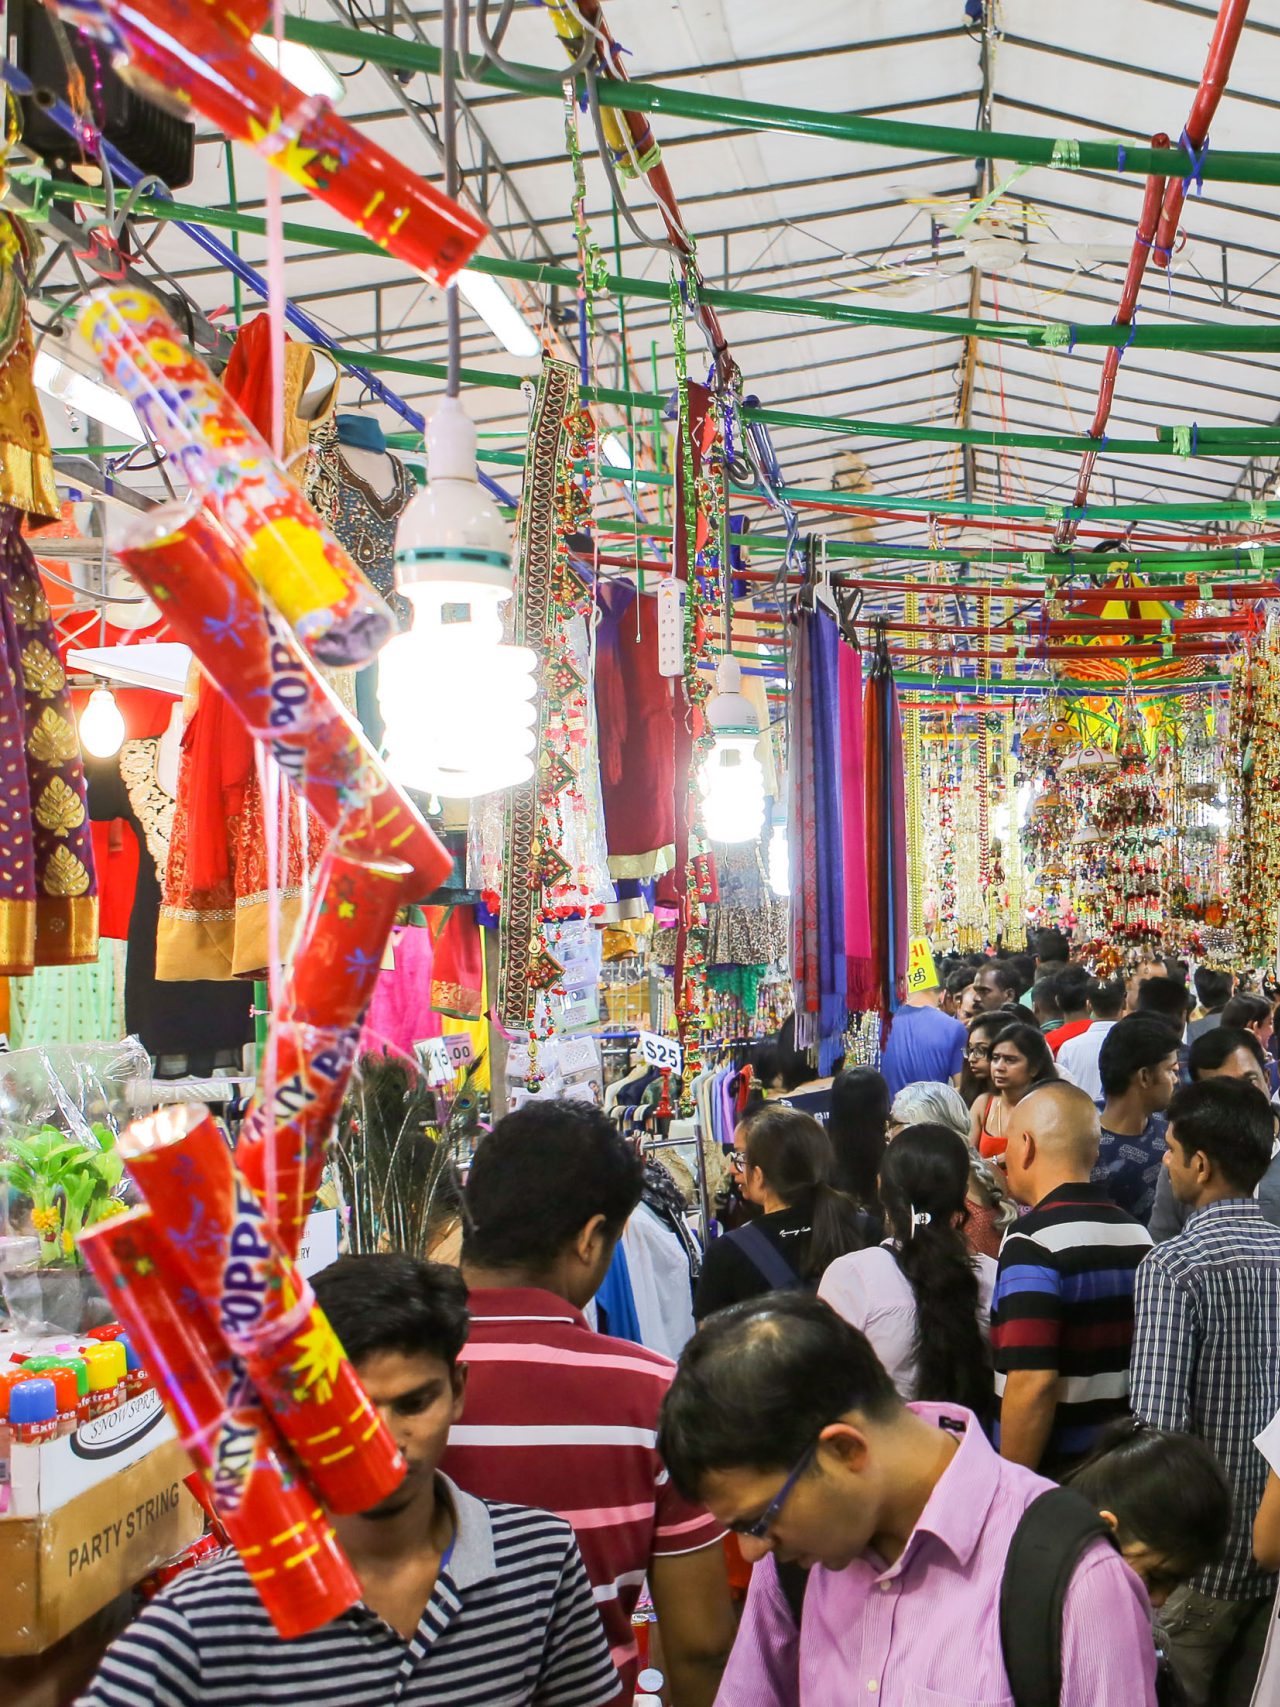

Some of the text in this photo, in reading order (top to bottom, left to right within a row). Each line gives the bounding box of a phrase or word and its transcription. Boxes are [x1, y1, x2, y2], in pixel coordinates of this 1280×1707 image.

[90, 1403, 128, 1439] SNOW
[68, 1482, 180, 1577] PARTY STRING
